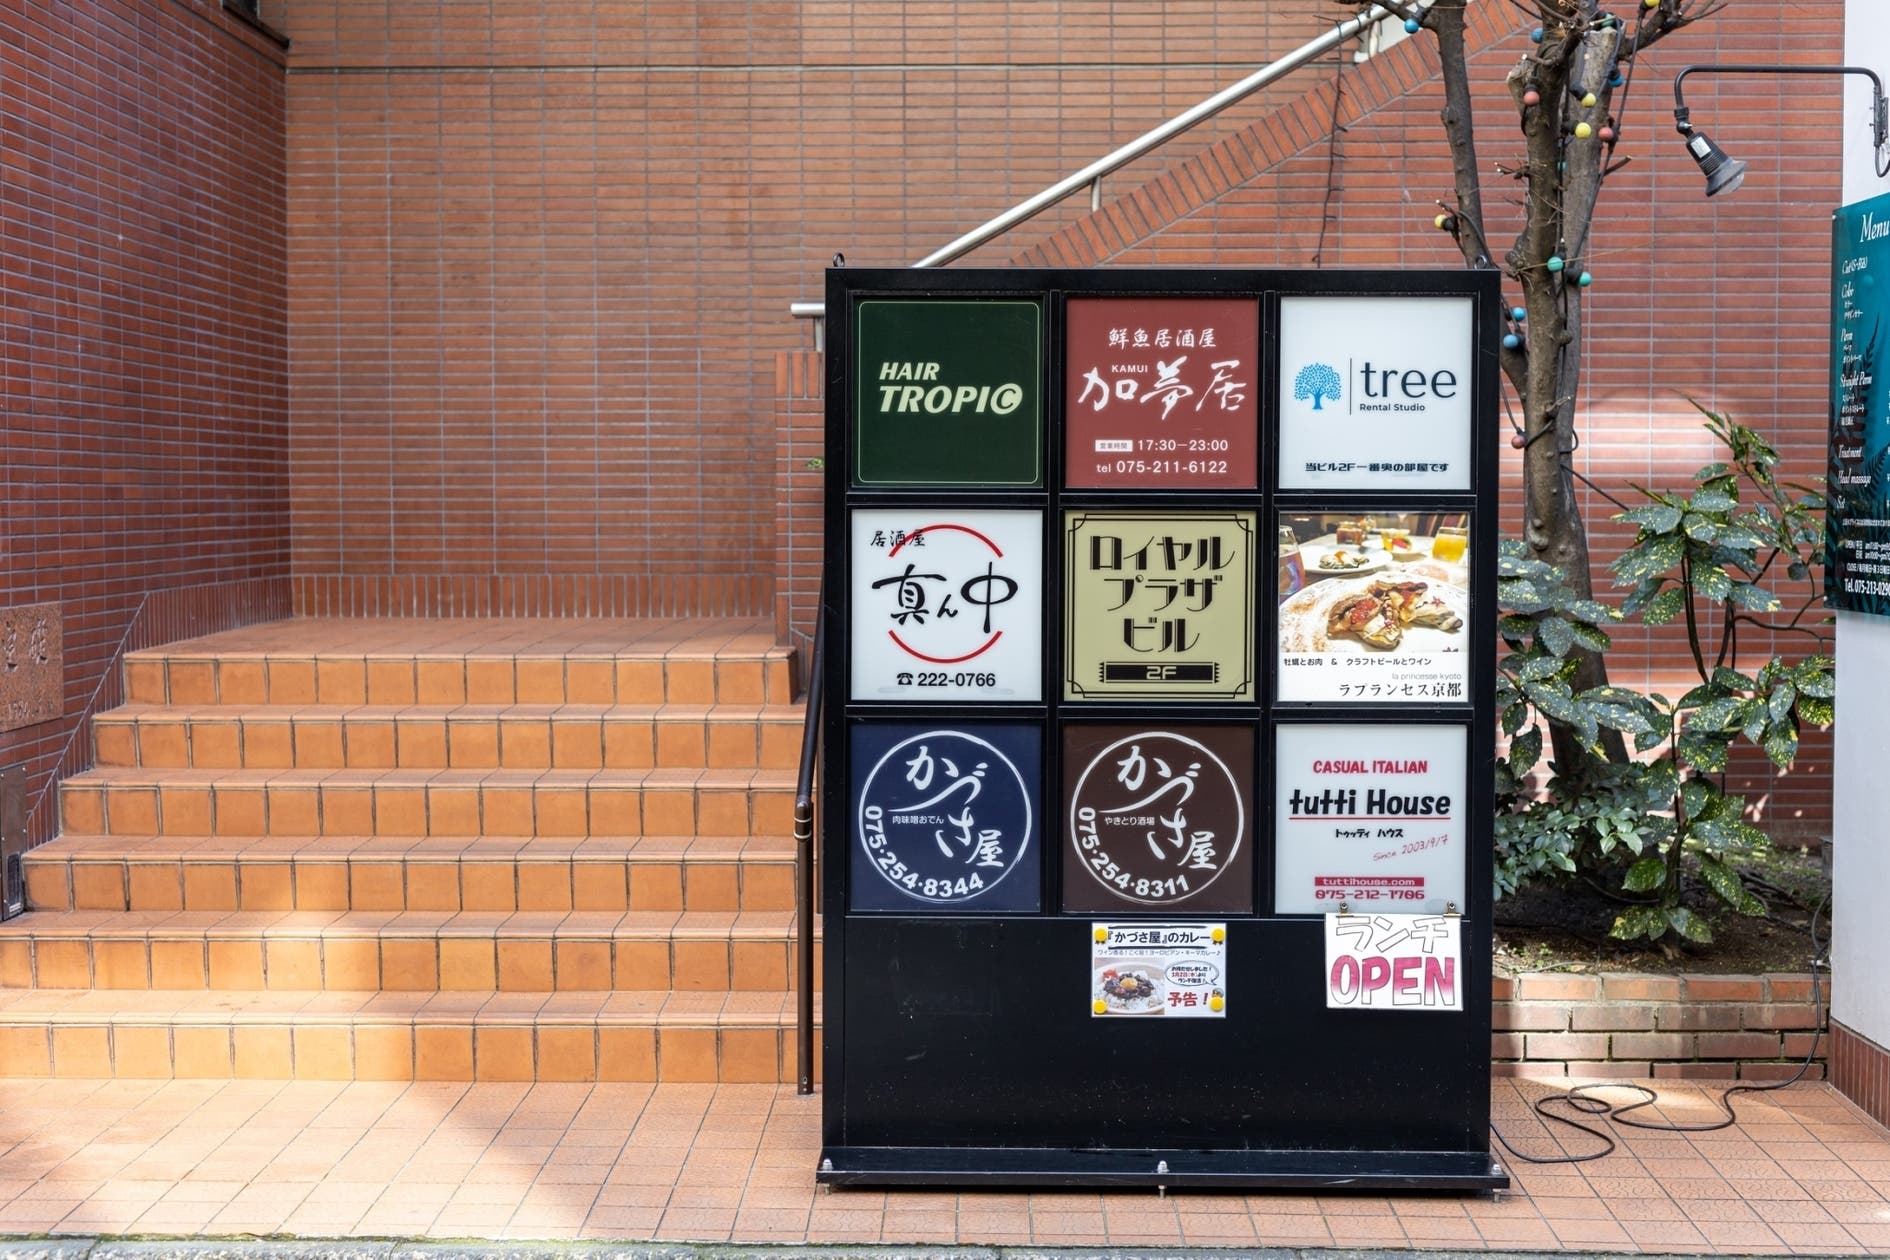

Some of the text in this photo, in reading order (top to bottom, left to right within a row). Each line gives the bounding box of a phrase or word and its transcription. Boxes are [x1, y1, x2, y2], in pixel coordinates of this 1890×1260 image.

[1860, 211, 1890, 242] Menu
[1108, 328, 1216, 350] 鮮魚居酒屋
[879, 362, 940, 380] HAIR
[1111, 364, 1148, 373] KAMUI
[1360, 362, 1457, 398] tree
[879, 383, 1023, 414] TROPIC
[1360, 403, 1425, 411] Rental Studio
[1097, 461, 1227, 473] tel 075-211-6122
[870, 529, 926, 547] 居酒屋
[1090, 536, 1235, 570] ロイヤル
[872, 561, 1018, 634] 真ん中
[1104, 575, 1223, 611] プラザ
[1123, 617, 1200, 652] ビル
[1331, 658, 1338, 666] &
[1346, 658, 1432, 666] クラフトビールとワイン
[917, 673, 996, 687] 222-0766
[1146, 666, 1177, 680] 2F
[1339, 682, 1462, 698] ラプランセス京都
[1313, 760, 1428, 774] CASUAL ITALIAN
[1289, 789, 1451, 815] tutti House
[1104, 817, 1156, 826] やきとり酒場
[1377, 828, 1404, 838] ハウス
[1323, 878, 1415, 886] tuttihouse.com
[1315, 890, 1424, 900] 075-212-1706
[1336, 916, 1448, 953] ランチ
[1330, 955, 1455, 1006] OPEN
